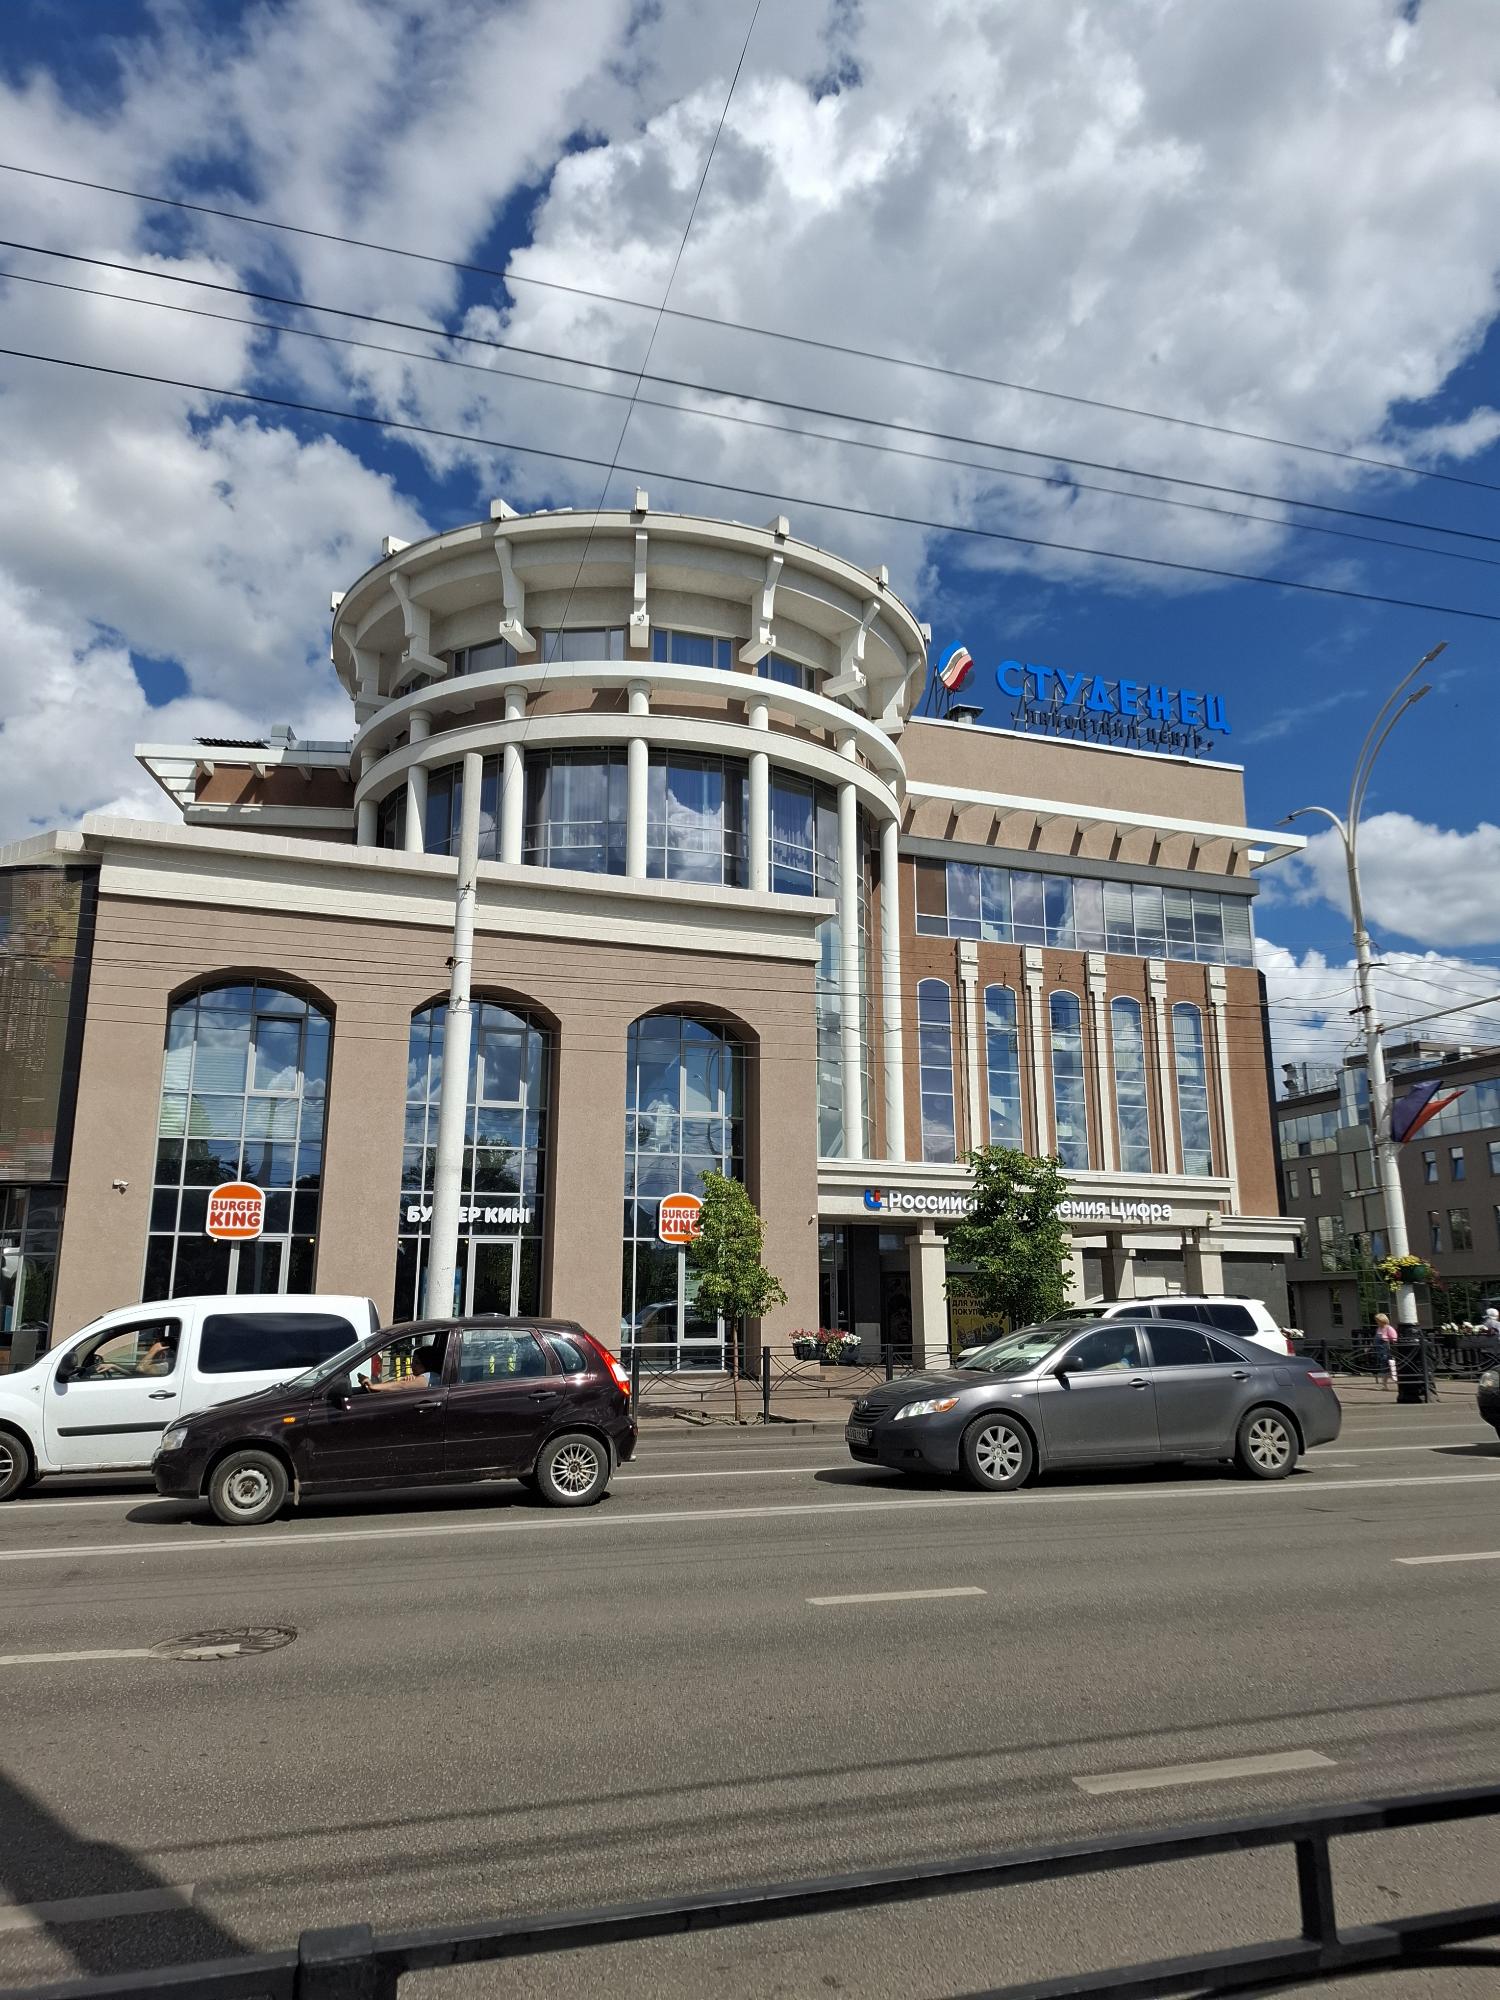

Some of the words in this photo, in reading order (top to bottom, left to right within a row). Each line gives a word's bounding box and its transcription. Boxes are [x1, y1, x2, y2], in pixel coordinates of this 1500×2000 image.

[995, 660, 1233, 735] СТУДЕНЕЦ
[211, 1200, 262, 1211] BURGER
[888, 1190, 978, 1211] Российс
[1111, 1199, 1173, 1221] Цифра
[209, 1211, 261, 1227] KING
[407, 1205, 482, 1223] БУЕР
[661, 1219, 703, 1233] KING
[952, 1299, 968, 1307] ДЛЯ
[952, 1308, 978, 1316] ПОКУП
